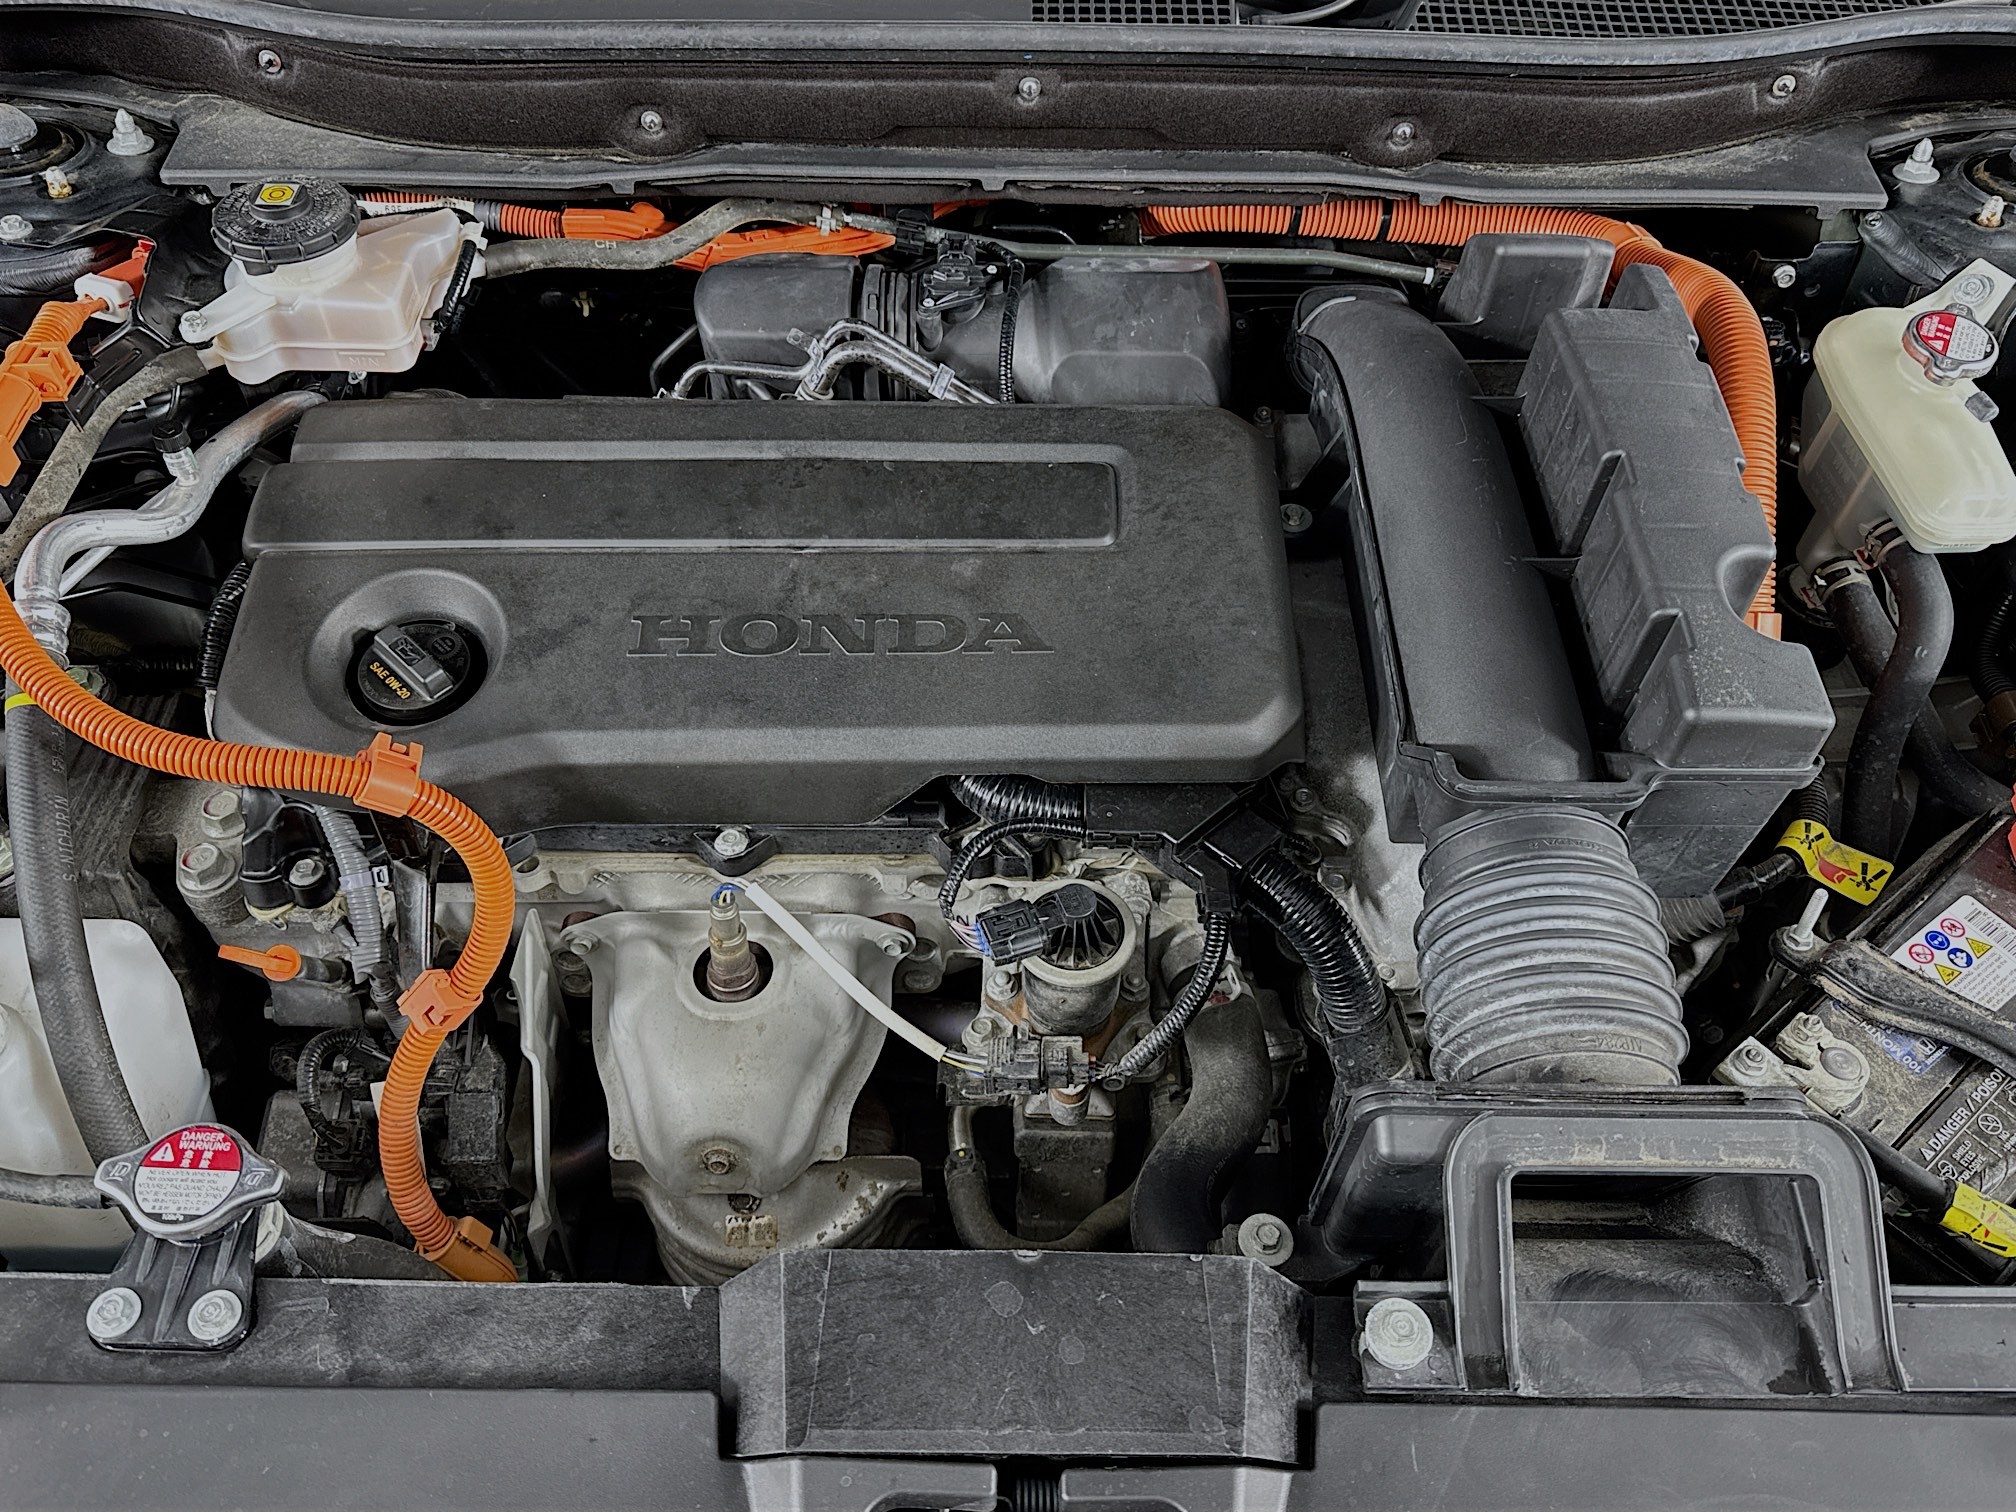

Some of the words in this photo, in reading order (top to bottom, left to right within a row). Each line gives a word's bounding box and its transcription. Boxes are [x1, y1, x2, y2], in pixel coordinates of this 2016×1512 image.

[594, 240, 617, 249] CH
[348, 356, 380, 368] MIN
[626, 613, 1055, 657] HONDA
[369, 662, 390, 680] SAE
[385, 676, 411, 699] 0W-20
[1860, 1020, 1904, 1057] MONTH
[1902, 1055, 1922, 1073] 100
[1925, 1046, 1950, 1066] HONDA
[181, 1131, 225, 1142] DANGER
[1928, 1107, 1972, 1151] DANGER
[179, 1140, 231, 1151] WARNUNG
[1952, 1140, 1972, 1161] SHIELD
[1957, 1153, 1987, 1183] EXPLOSIVE
[1959, 1150, 1976, 1168] EYES
